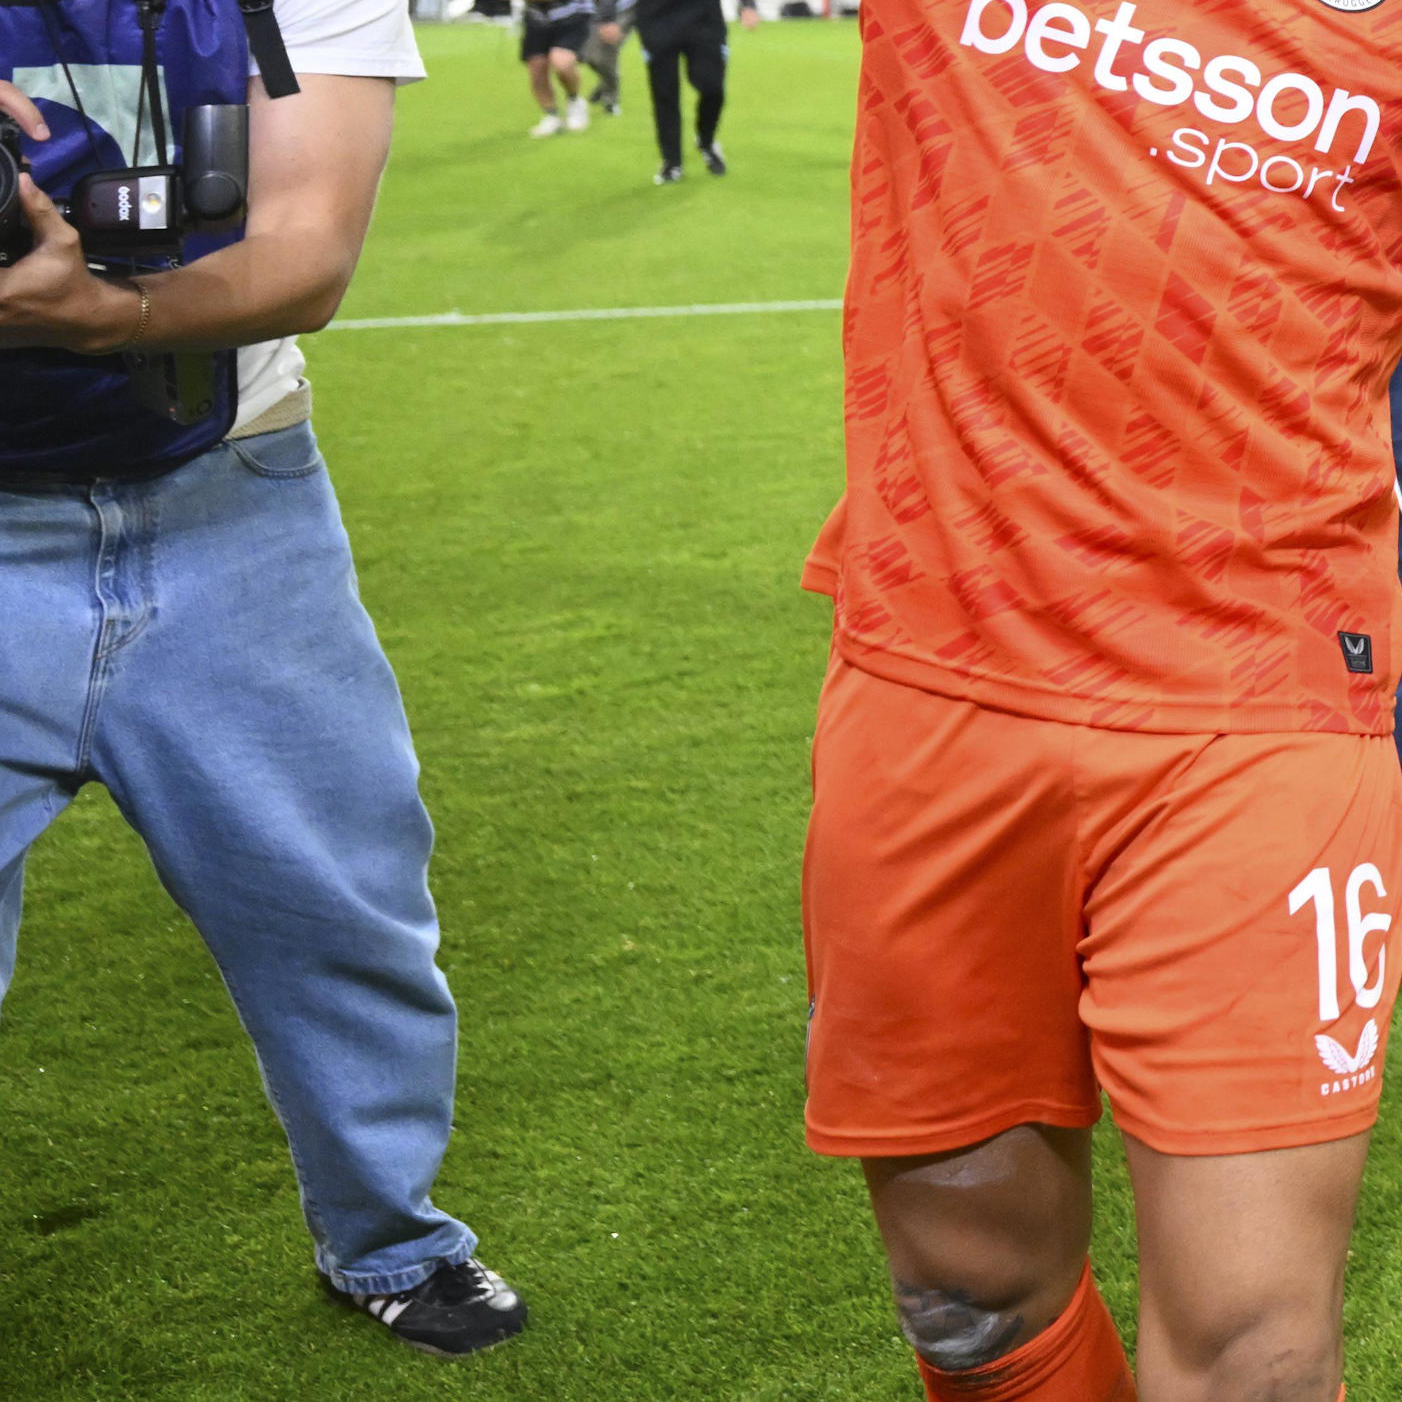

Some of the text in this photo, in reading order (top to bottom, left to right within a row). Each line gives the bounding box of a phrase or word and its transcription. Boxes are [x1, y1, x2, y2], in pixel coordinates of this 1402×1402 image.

[1150, 128, 1354, 212] .sport
[118, 186, 132, 221] Godox
[1288, 862, 1392, 1022] 16
[1321, 1065, 1376, 1096] CASTORE
